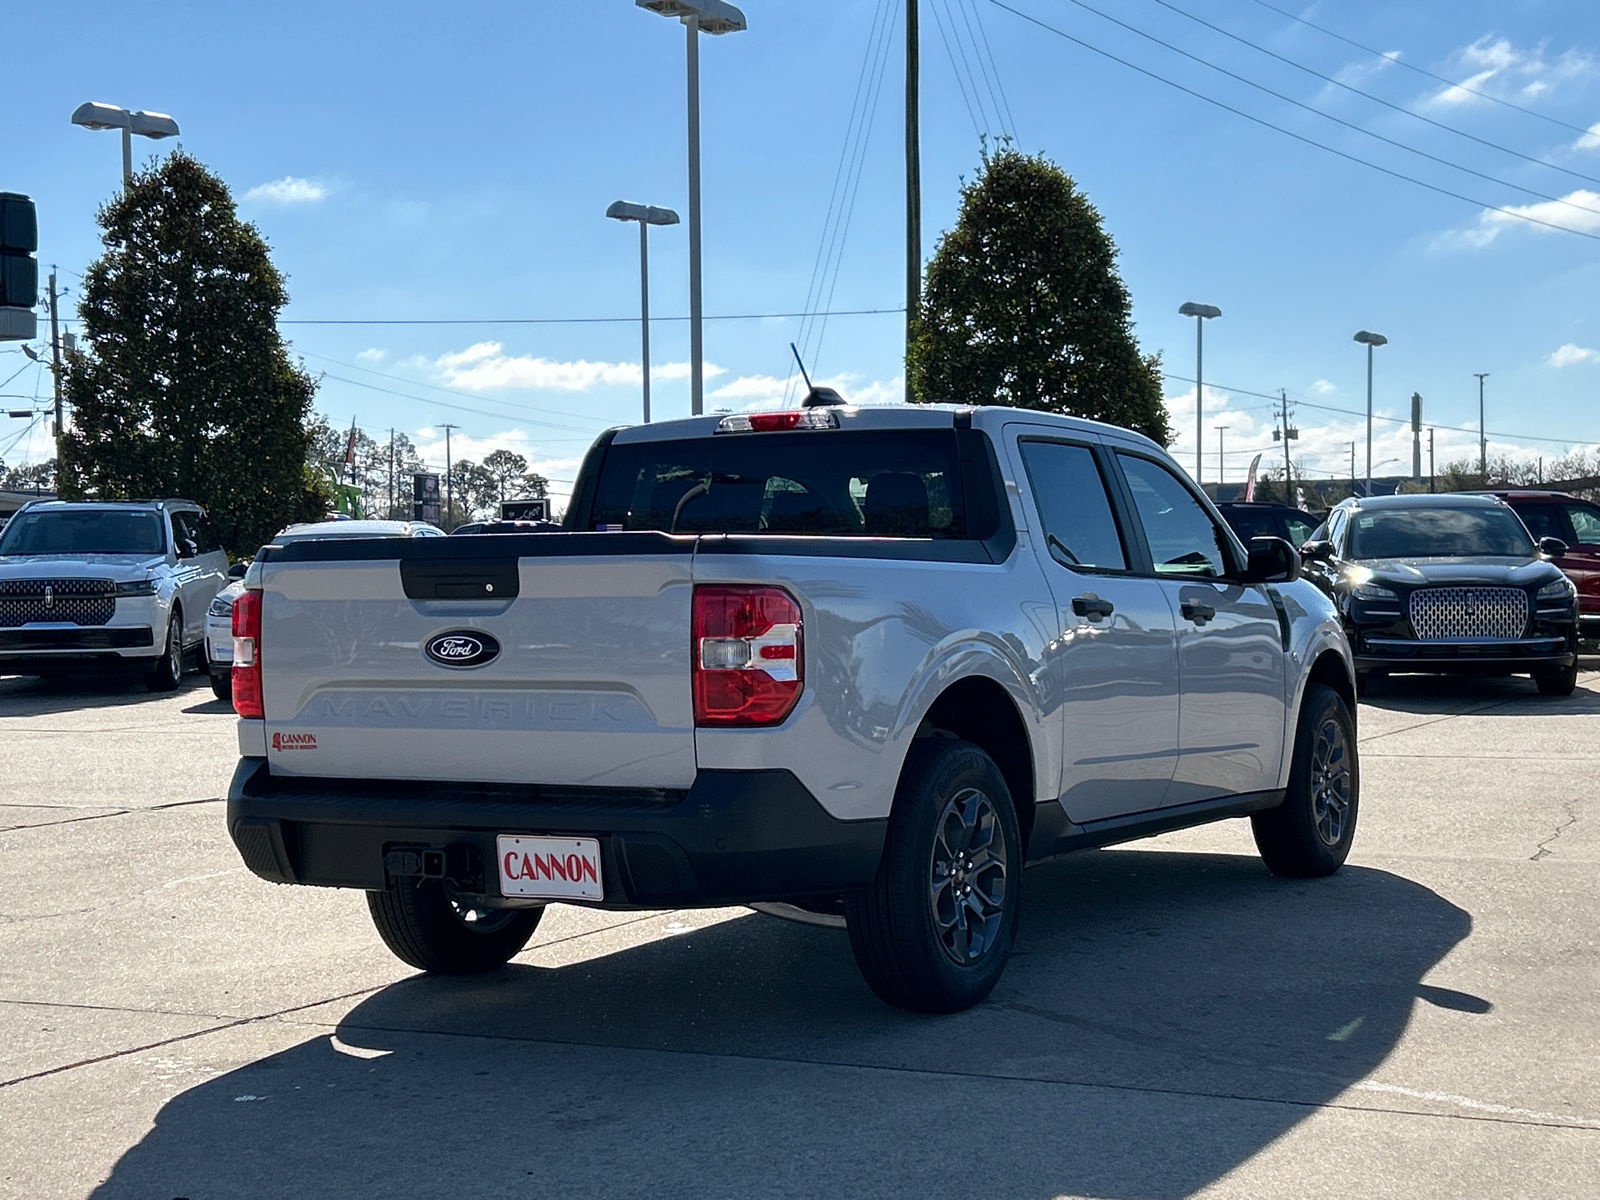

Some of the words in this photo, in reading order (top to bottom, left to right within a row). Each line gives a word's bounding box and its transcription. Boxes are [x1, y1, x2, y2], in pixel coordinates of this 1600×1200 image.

[440, 639, 473, 656] Ford
[321, 695, 623, 722] MAVERICK
[281, 733, 317, 744] CANNON
[503, 851, 598, 884] CANNON
